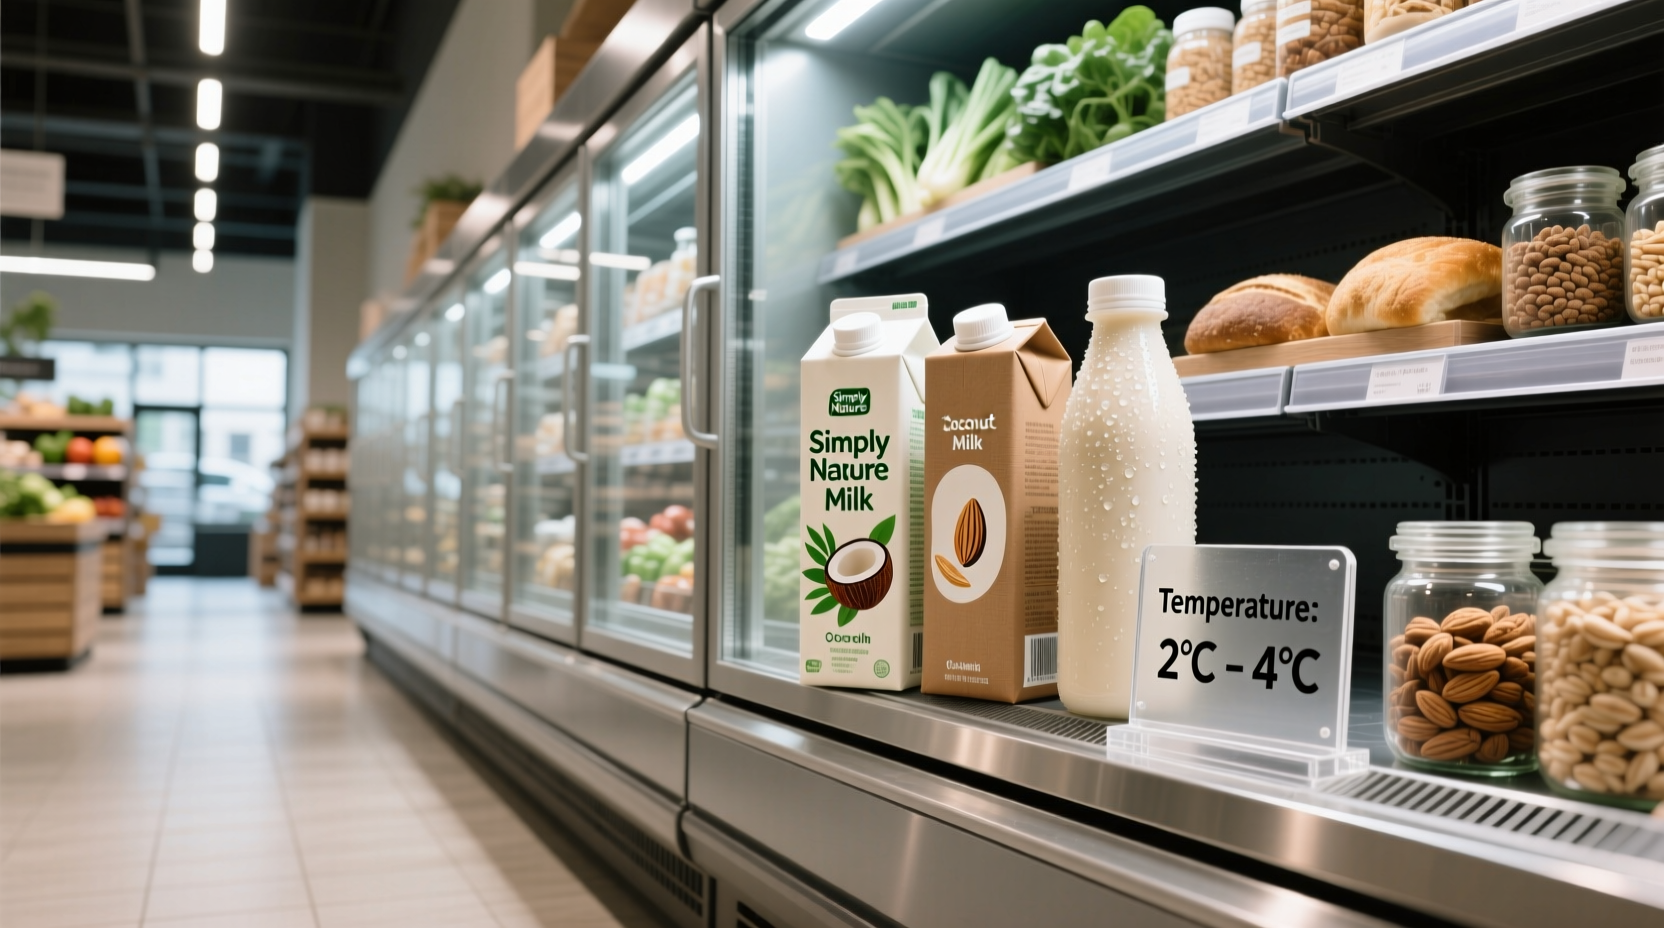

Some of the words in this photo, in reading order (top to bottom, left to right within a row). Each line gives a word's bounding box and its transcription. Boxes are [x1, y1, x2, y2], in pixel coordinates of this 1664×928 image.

[809, 429, 890, 460] Simply
[952, 433, 983, 451] Milk
[810, 458, 889, 481] Nature
[825, 486, 874, 511] Milk
[1159, 588, 1319, 623] Temperature:
[1157, 638, 1217, 684] 2°C
[1252, 646, 1321, 694] 4°C
